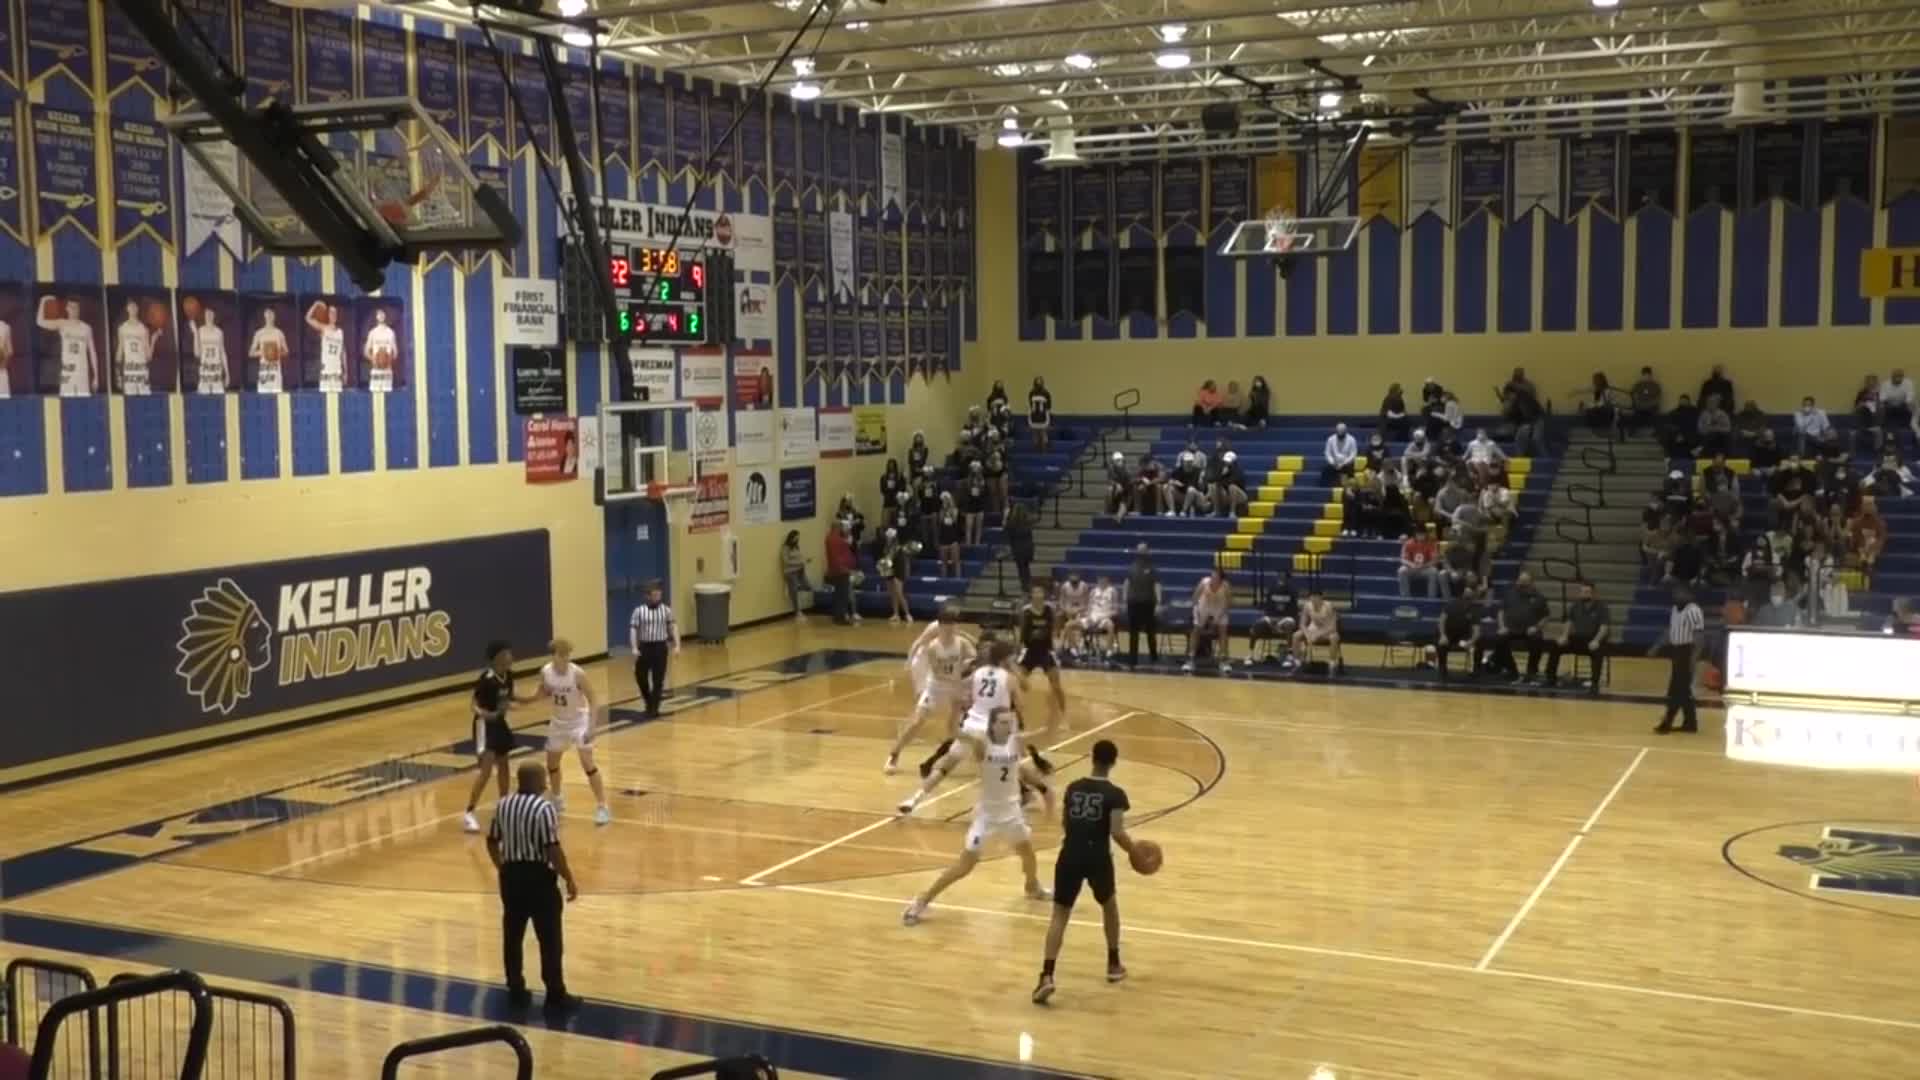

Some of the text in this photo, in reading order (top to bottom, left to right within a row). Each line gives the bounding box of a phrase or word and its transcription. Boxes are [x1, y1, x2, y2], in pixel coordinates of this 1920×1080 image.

[692, 265, 703, 288] 9
[515, 291, 545, 302] FIRST
[661, 281, 670, 300] 2
[504, 303, 556, 315] FINANCIAL
[516, 314, 545, 326] BANK
[619, 311, 630, 331] 6
[689, 314, 699, 333] 2
[278, 567, 432, 632] KELLER
[279, 611, 451, 686] INDIANS
[978, 679, 998, 698] 23
[1000, 767, 1009, 782] 2
[1070, 793, 1104, 822] 35
